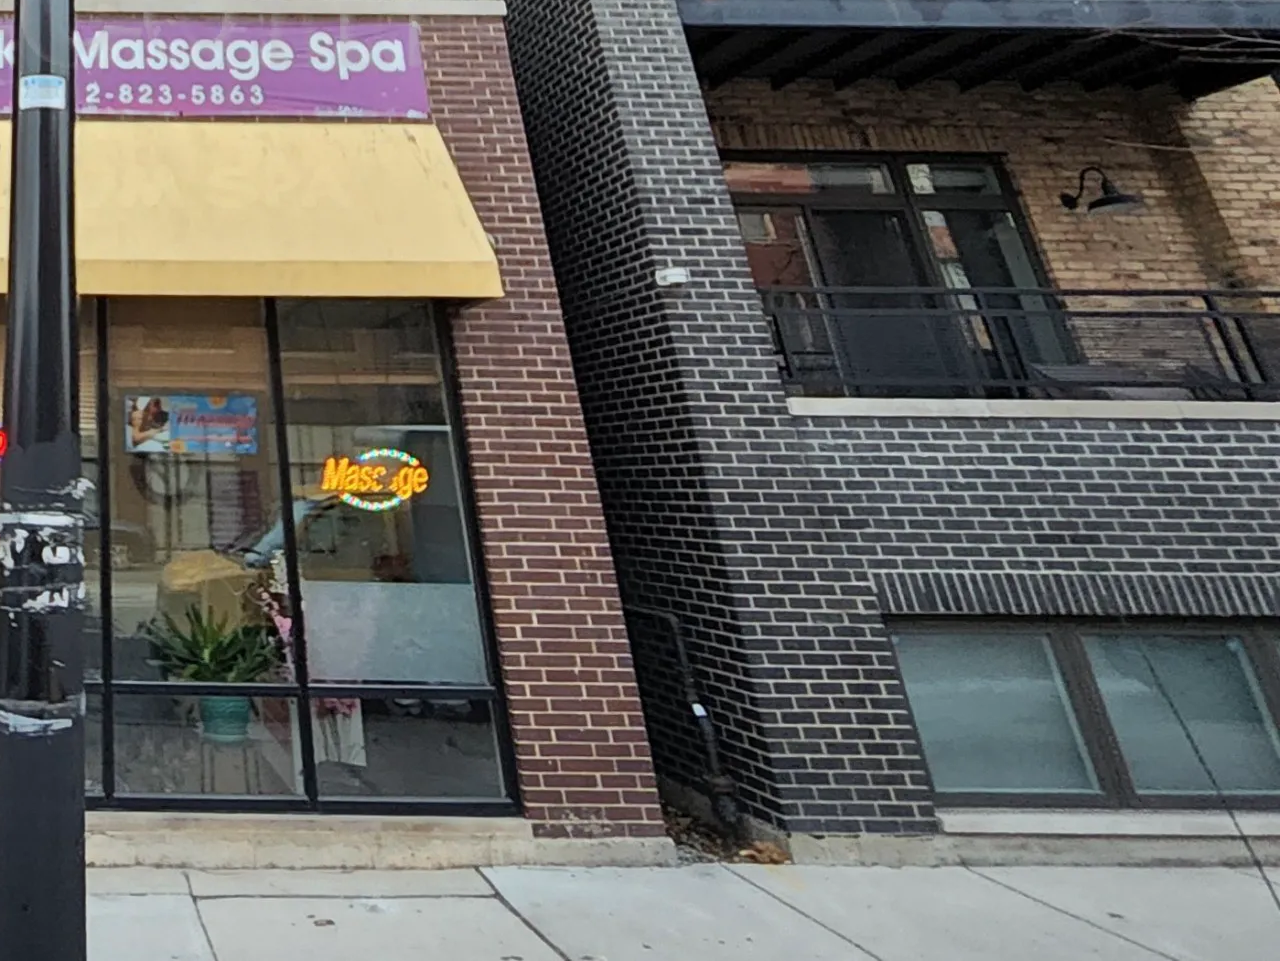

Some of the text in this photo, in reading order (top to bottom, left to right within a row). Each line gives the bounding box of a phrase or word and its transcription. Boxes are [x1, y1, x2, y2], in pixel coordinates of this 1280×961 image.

[73, 30, 294, 81] Massage
[309, 31, 407, 81] Spa
[85, 81, 265, 106] 2-823-5863
